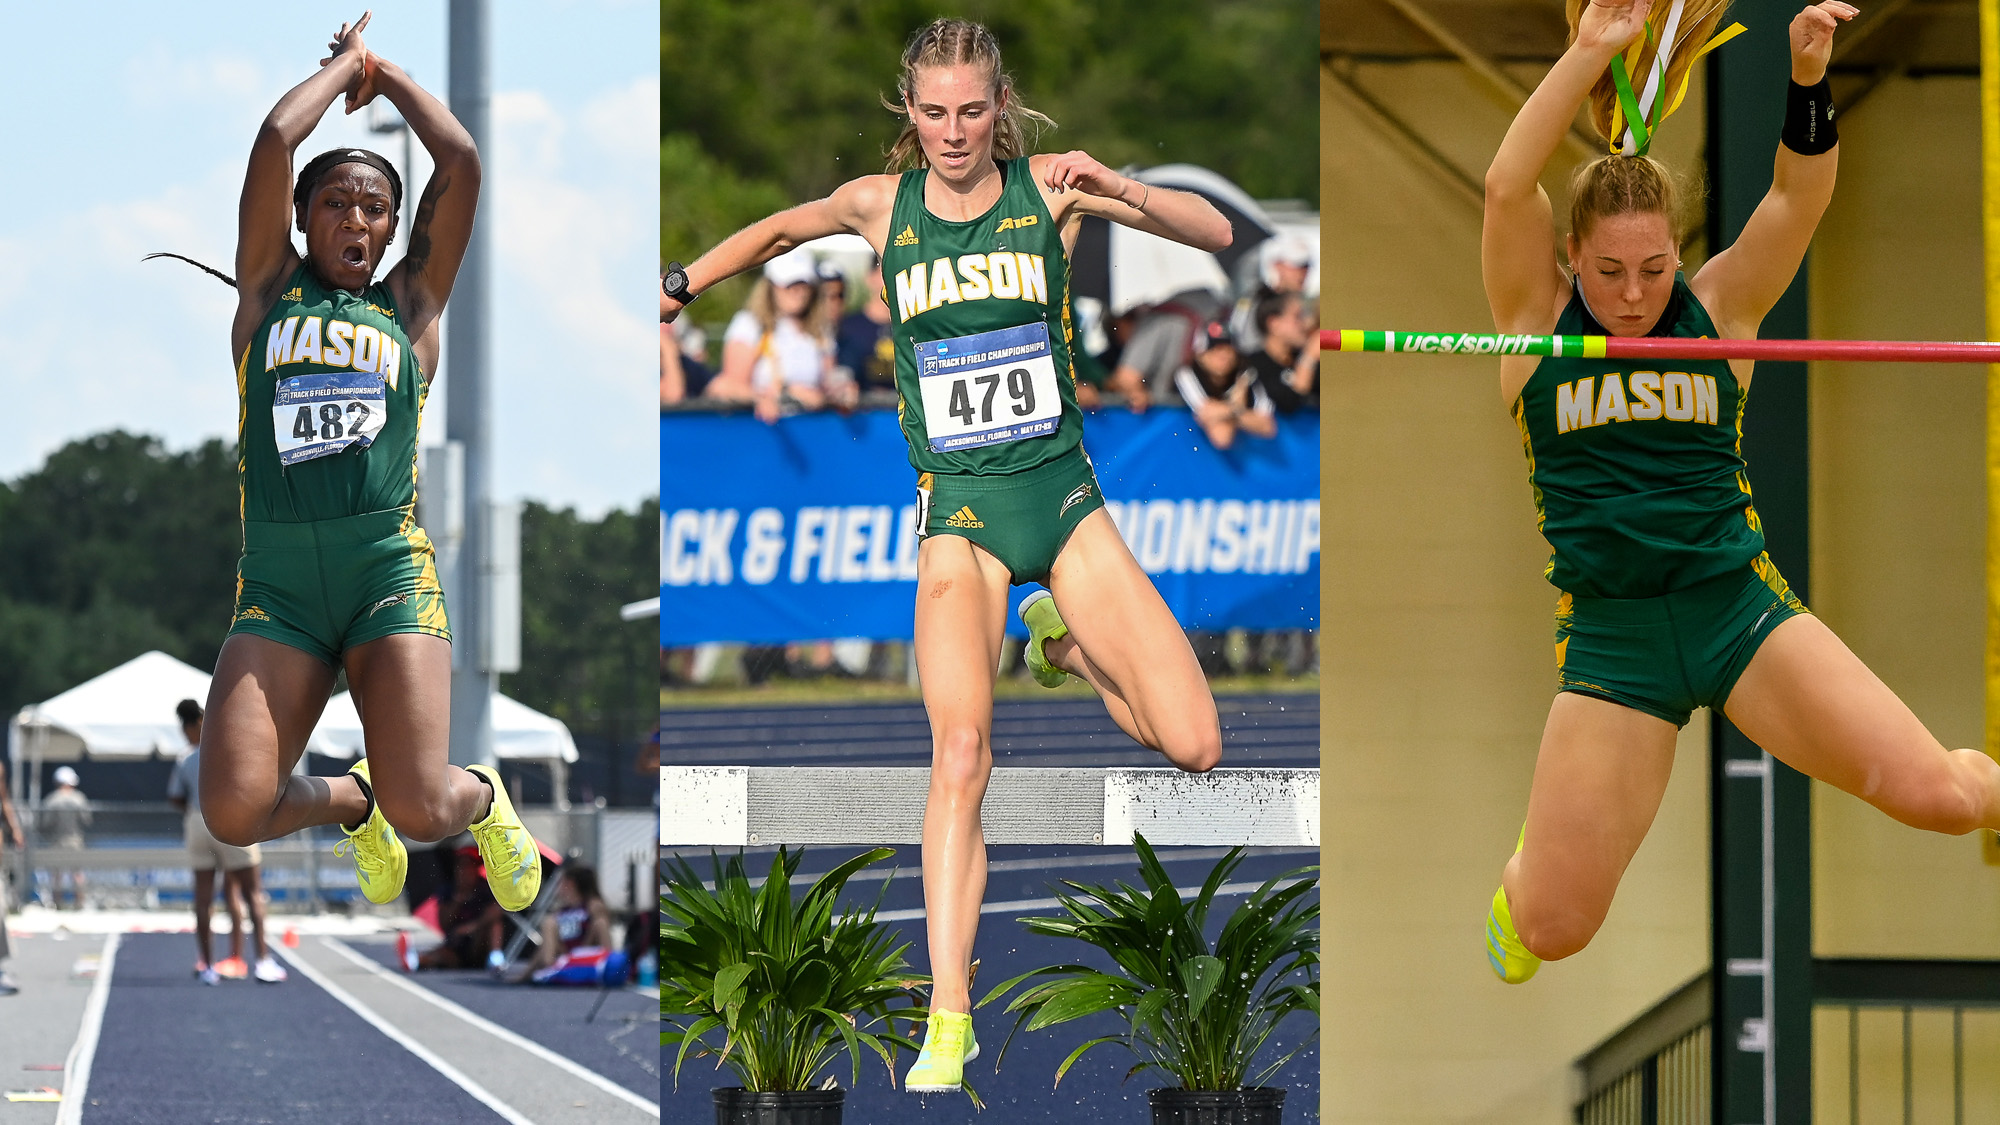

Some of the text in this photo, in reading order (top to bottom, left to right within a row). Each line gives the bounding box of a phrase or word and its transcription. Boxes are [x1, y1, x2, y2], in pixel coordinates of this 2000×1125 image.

[995, 214, 1038, 233] A10
[894, 237, 919, 247] adidas
[895, 251, 1048, 324] MASON
[265, 315, 401, 392] MASON
[937, 357, 960, 369] TRACK
[966, 353, 987, 365] FIELD
[987, 341, 1045, 361] CHAMPIONSHIPS
[1402, 333, 1543, 355] ucs/spirit
[289, 391, 309, 399] TRACK
[314, 388, 331, 397] FIELD
[332, 387, 381, 396] CHAMPIONSHIPS
[949, 368, 1036, 426] 479
[1556, 370, 1719, 435] MASON
[292, 401, 370, 443] 482
[987, 430, 1012, 441] FLORIDA
[1020, 425, 1034, 435] MAY
[945, 518, 985, 529] adidas
[741, 507, 787, 585] &
[238, 613, 270, 621] adidas
